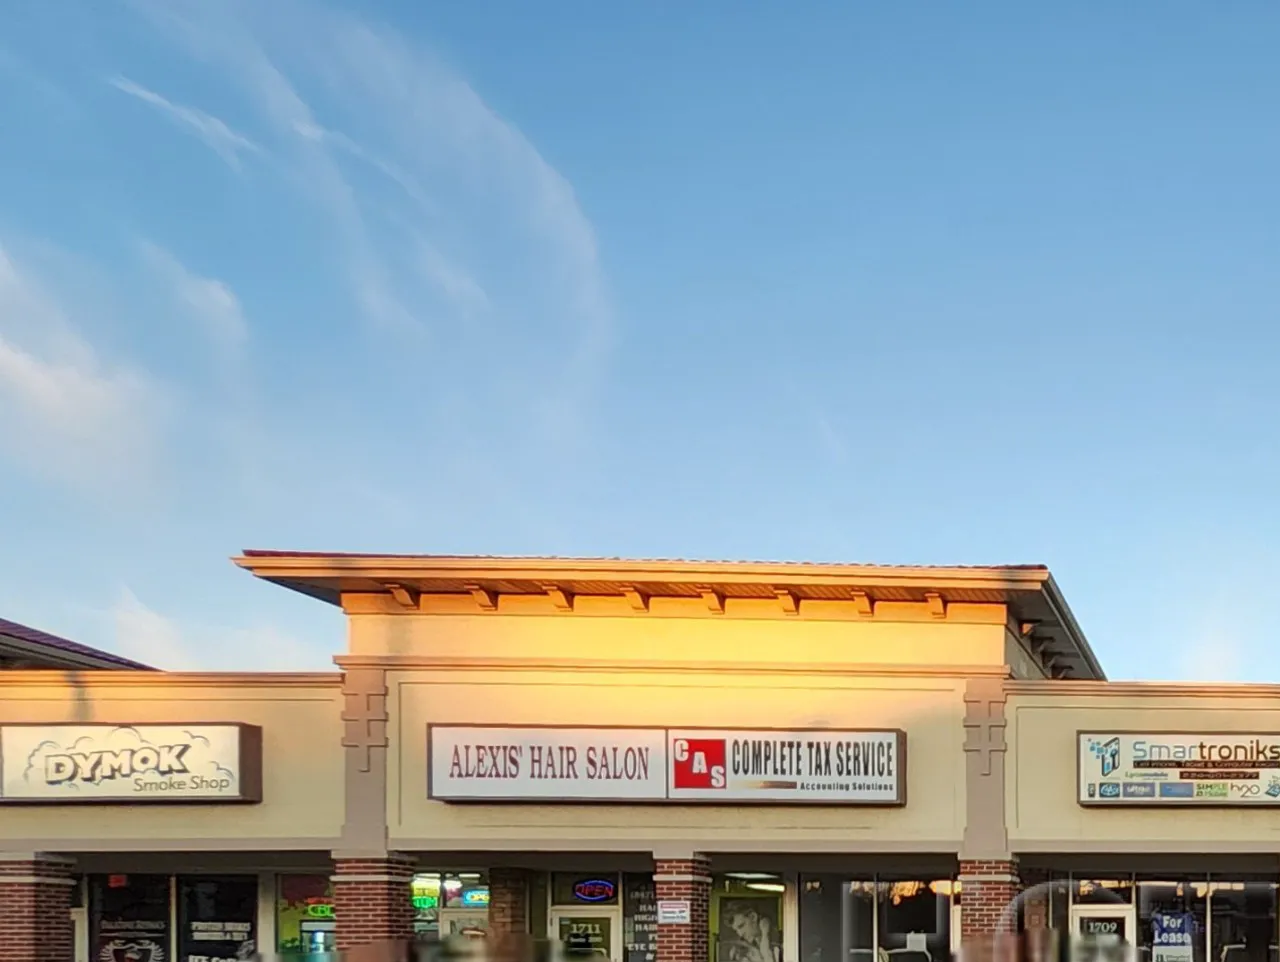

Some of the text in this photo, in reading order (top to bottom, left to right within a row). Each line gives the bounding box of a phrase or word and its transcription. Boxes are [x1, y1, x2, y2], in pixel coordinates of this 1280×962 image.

[45, 744, 191, 785] DYMOK
[449, 744, 650, 781] ALEXIS' HAIR SALON
[732, 740, 893, 777] COMPLETE TAX SERVICE
[133, 776, 230, 792] Smoke Shop
[800, 782, 894, 792] Accounting Solutions
[575, 884, 614, 897] OPEN
[1089, 922, 1117, 932] 1709
[1163, 916, 1183, 929] For
[1154, 930, 1192, 944] Lease
